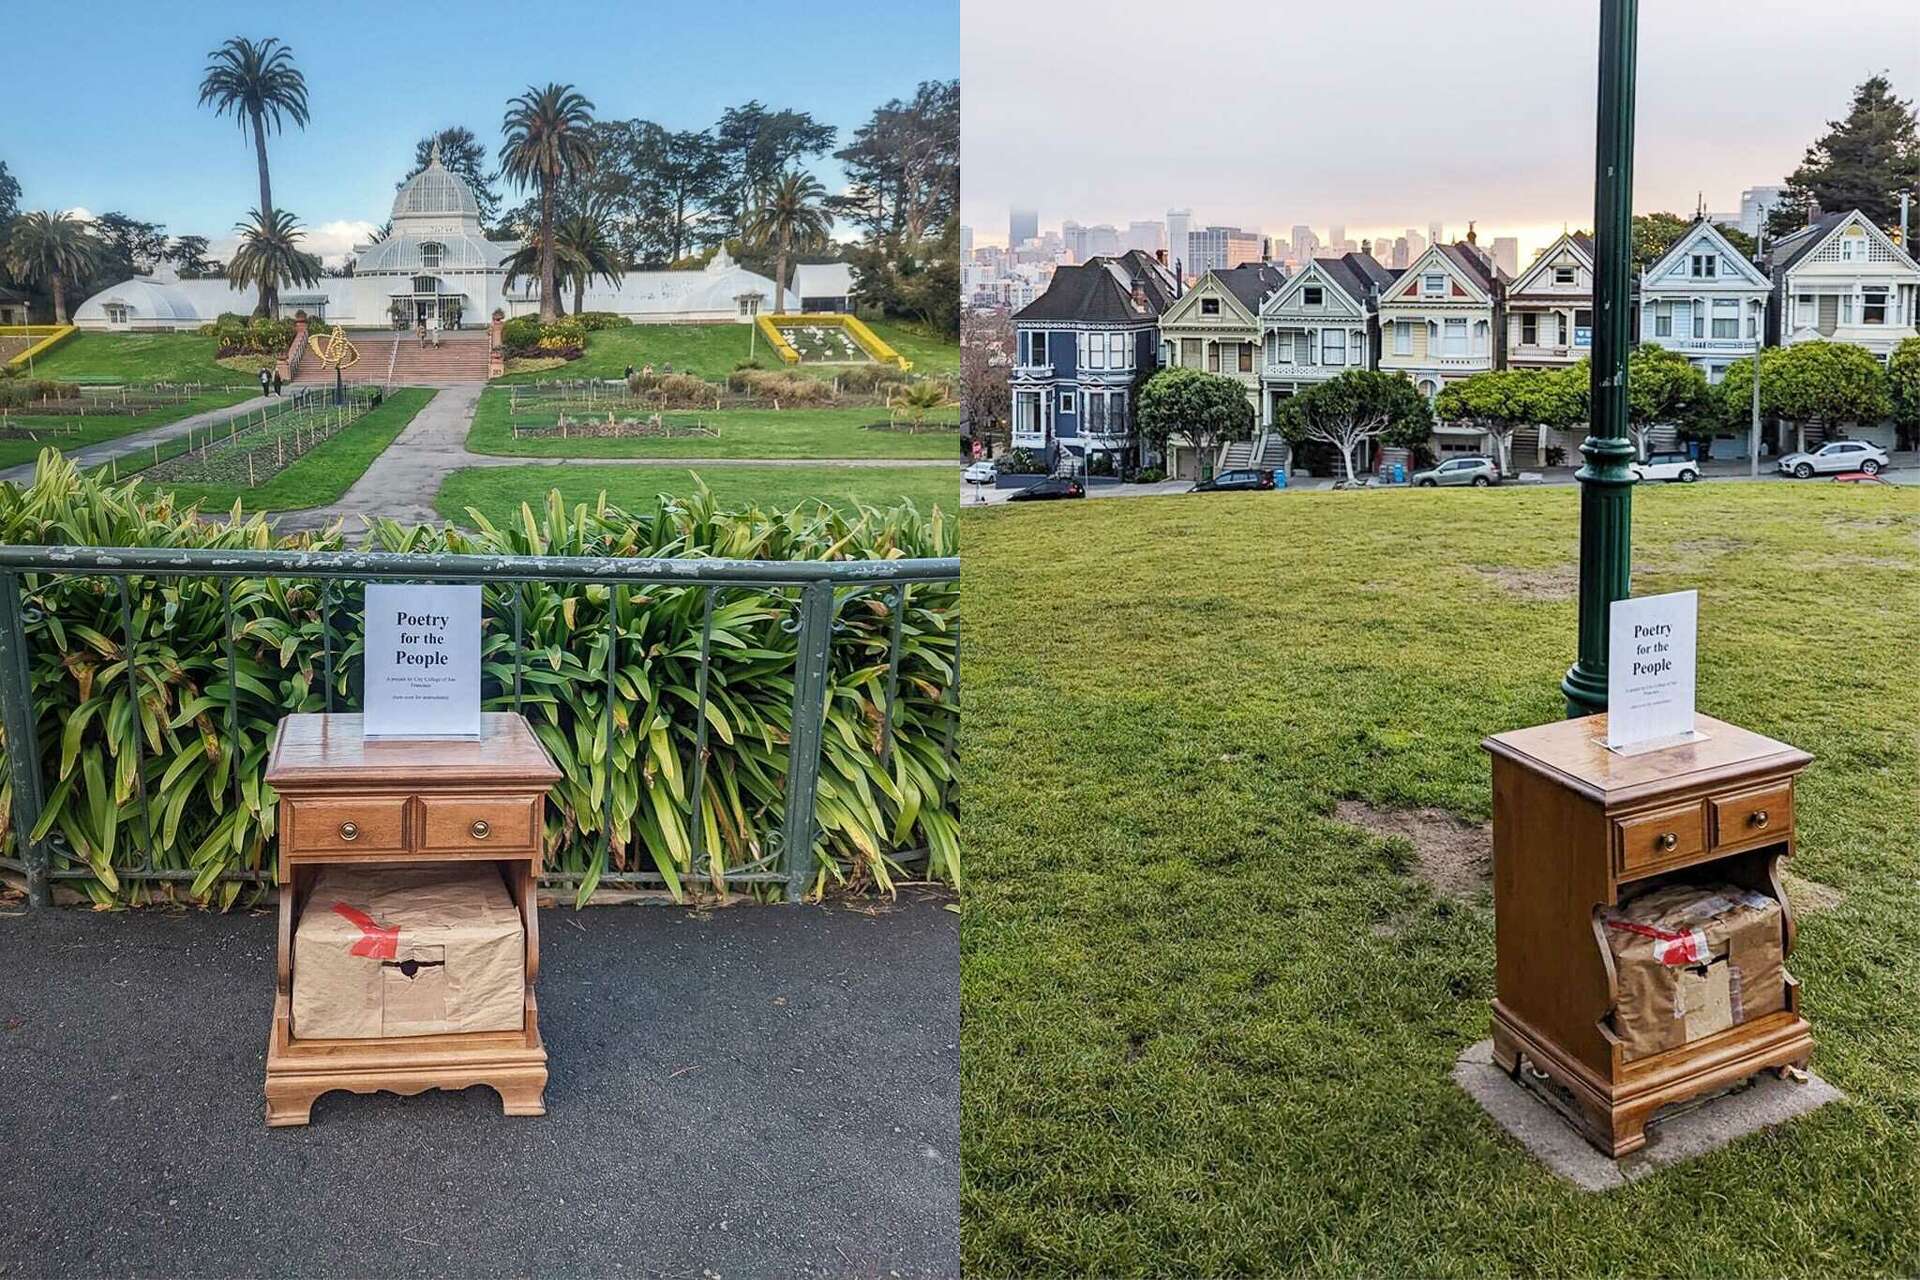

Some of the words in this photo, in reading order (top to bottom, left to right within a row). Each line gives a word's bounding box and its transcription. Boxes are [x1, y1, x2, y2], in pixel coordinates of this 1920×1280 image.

[397, 611, 449, 630] Poetry
[401, 632, 421, 645] for
[424, 632, 444, 645] the
[1634, 623, 1672, 639] Poetry
[1636, 643, 1651, 656] for
[1654, 641, 1669, 653] the
[396, 650, 449, 669] People
[1633, 658, 1672, 676] People
